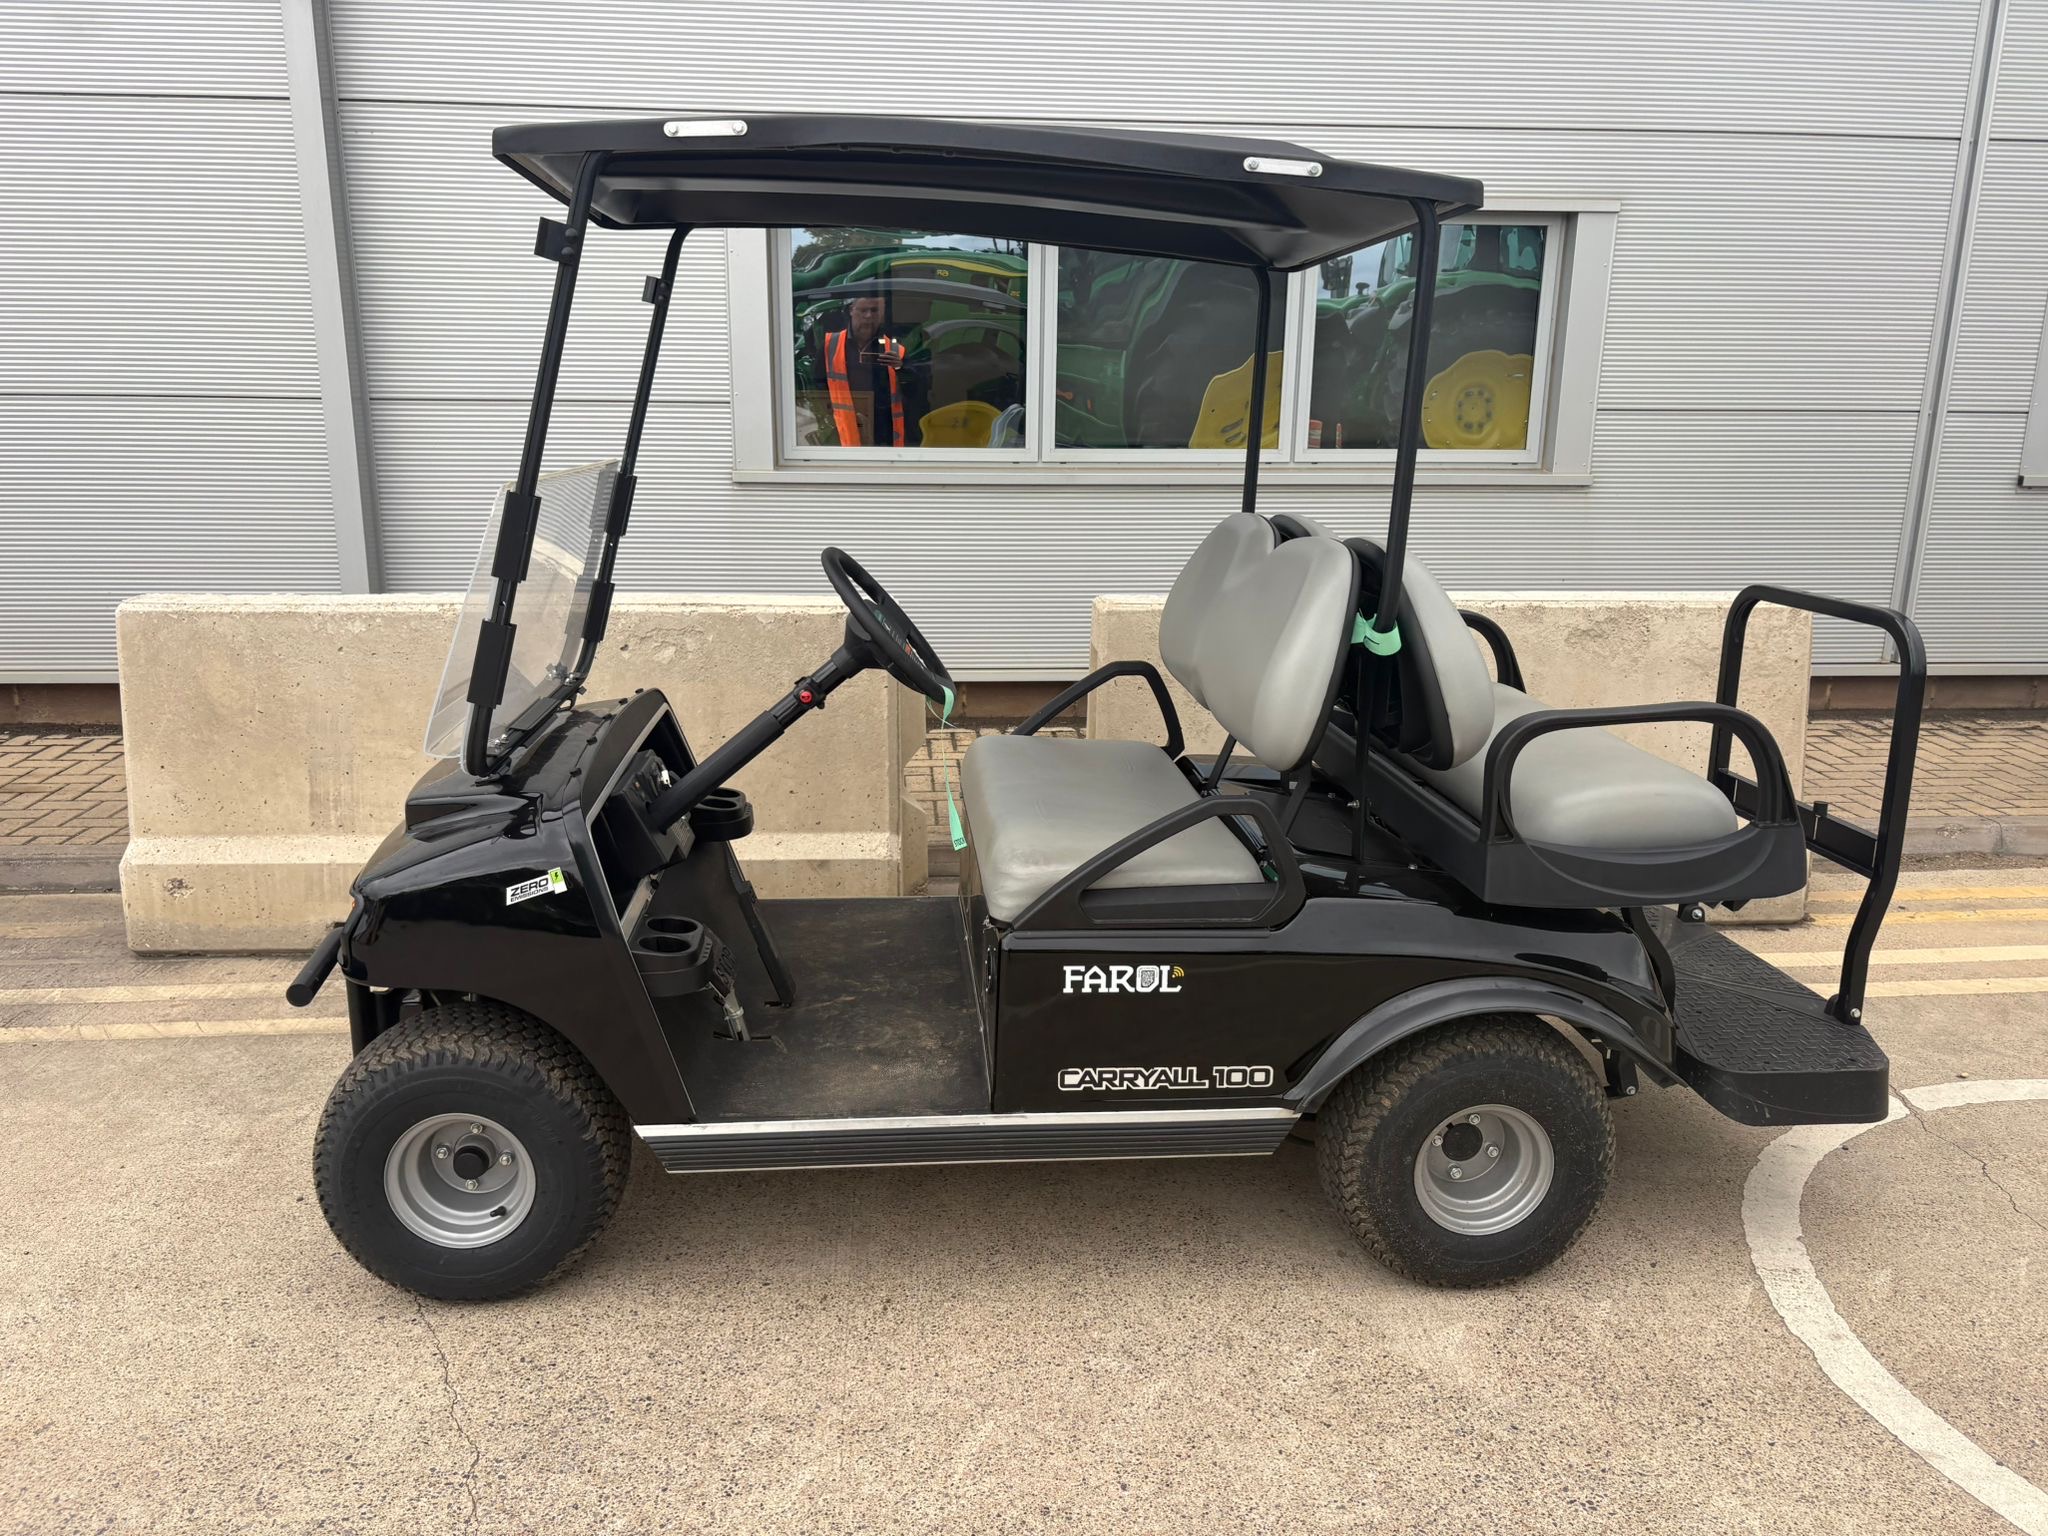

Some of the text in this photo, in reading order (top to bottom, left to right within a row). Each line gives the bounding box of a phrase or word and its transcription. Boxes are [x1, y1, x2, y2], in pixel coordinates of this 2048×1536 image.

[510, 877, 549, 897] ZERO
[1062, 965, 1182, 993] FAROL
[1058, 1065, 1274, 1091] CARRYALL 100
